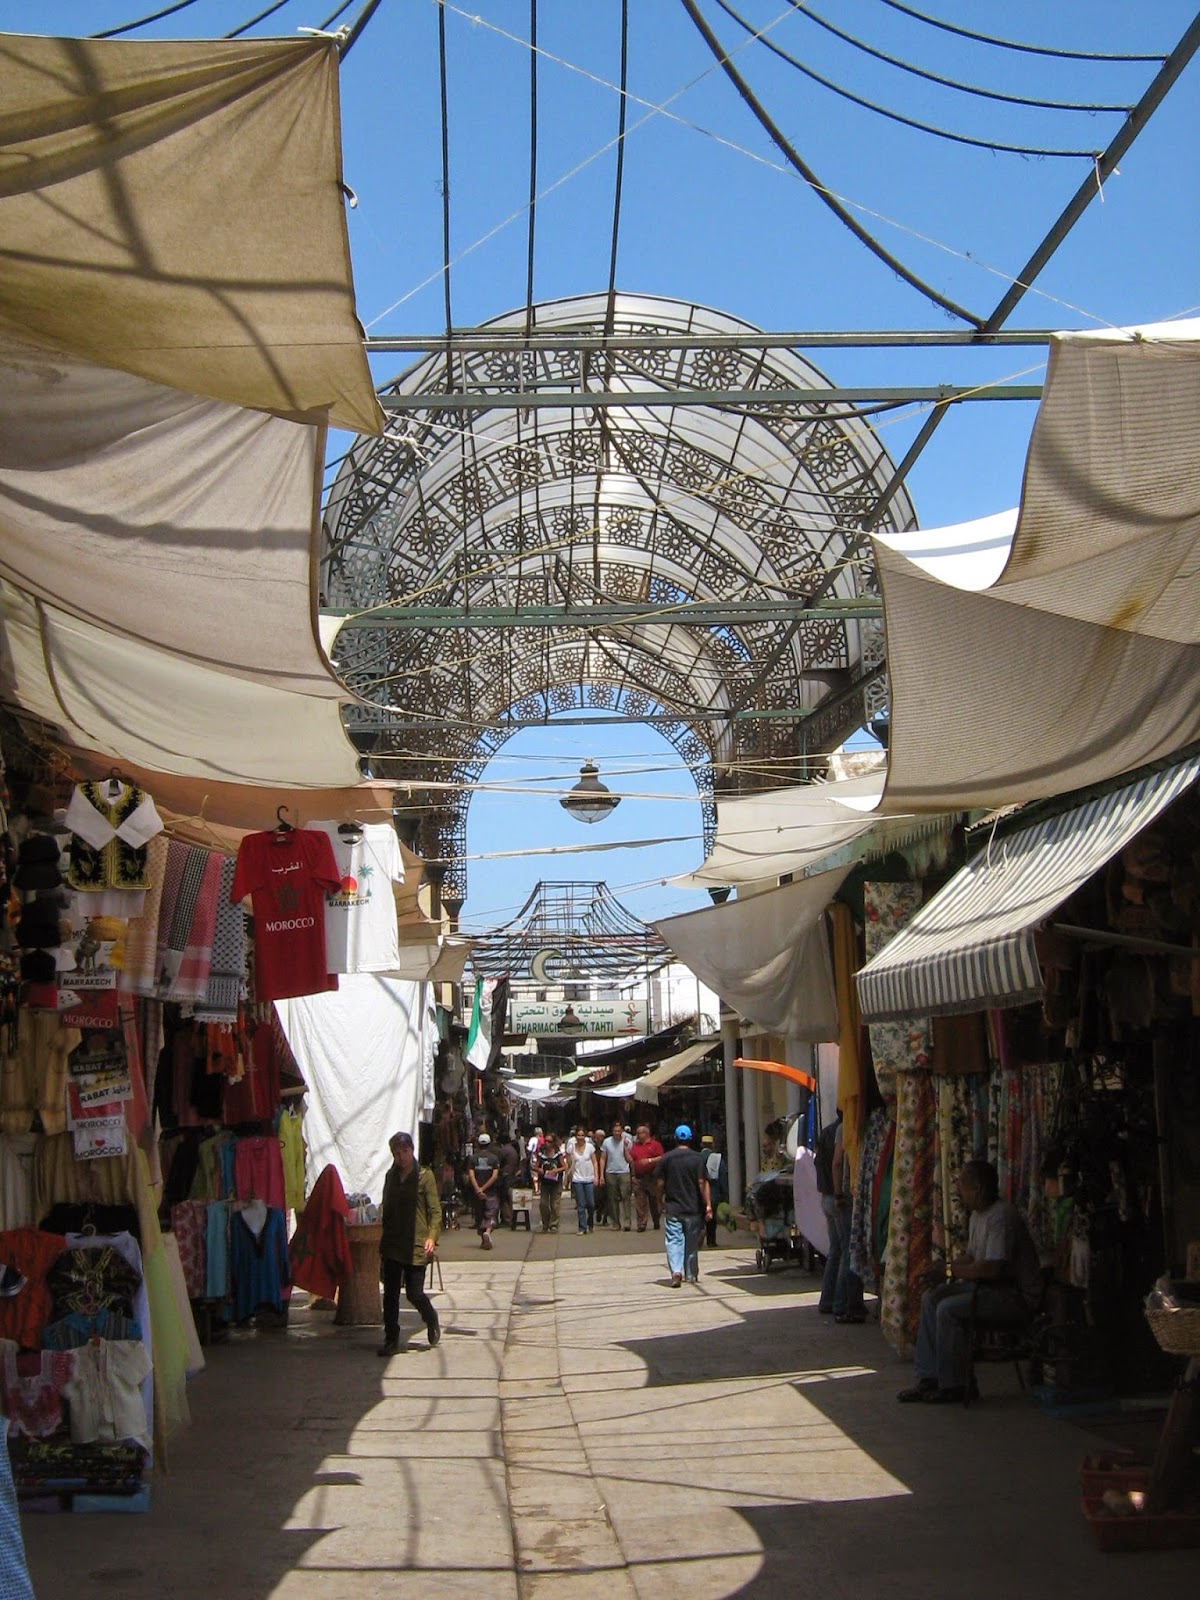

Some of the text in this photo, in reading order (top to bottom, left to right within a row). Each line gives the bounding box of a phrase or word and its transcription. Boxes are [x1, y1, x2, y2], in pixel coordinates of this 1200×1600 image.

[328, 898, 370, 908] MARRAKECH
[265, 916, 315, 933] MOROCCO
[62, 978, 112, 987] MARRAKECH
[578, 1003, 614, 1018] صيدلية
[63, 1015, 114, 1029] MOROCCO
[591, 1020, 614, 1032] TAHTI
[72, 1062, 103, 1073] RABAT
[80, 1088, 110, 1102] RABAT
[76, 1118, 121, 1129] MOROCCO
[75, 1146, 123, 1160] MOROCCO
